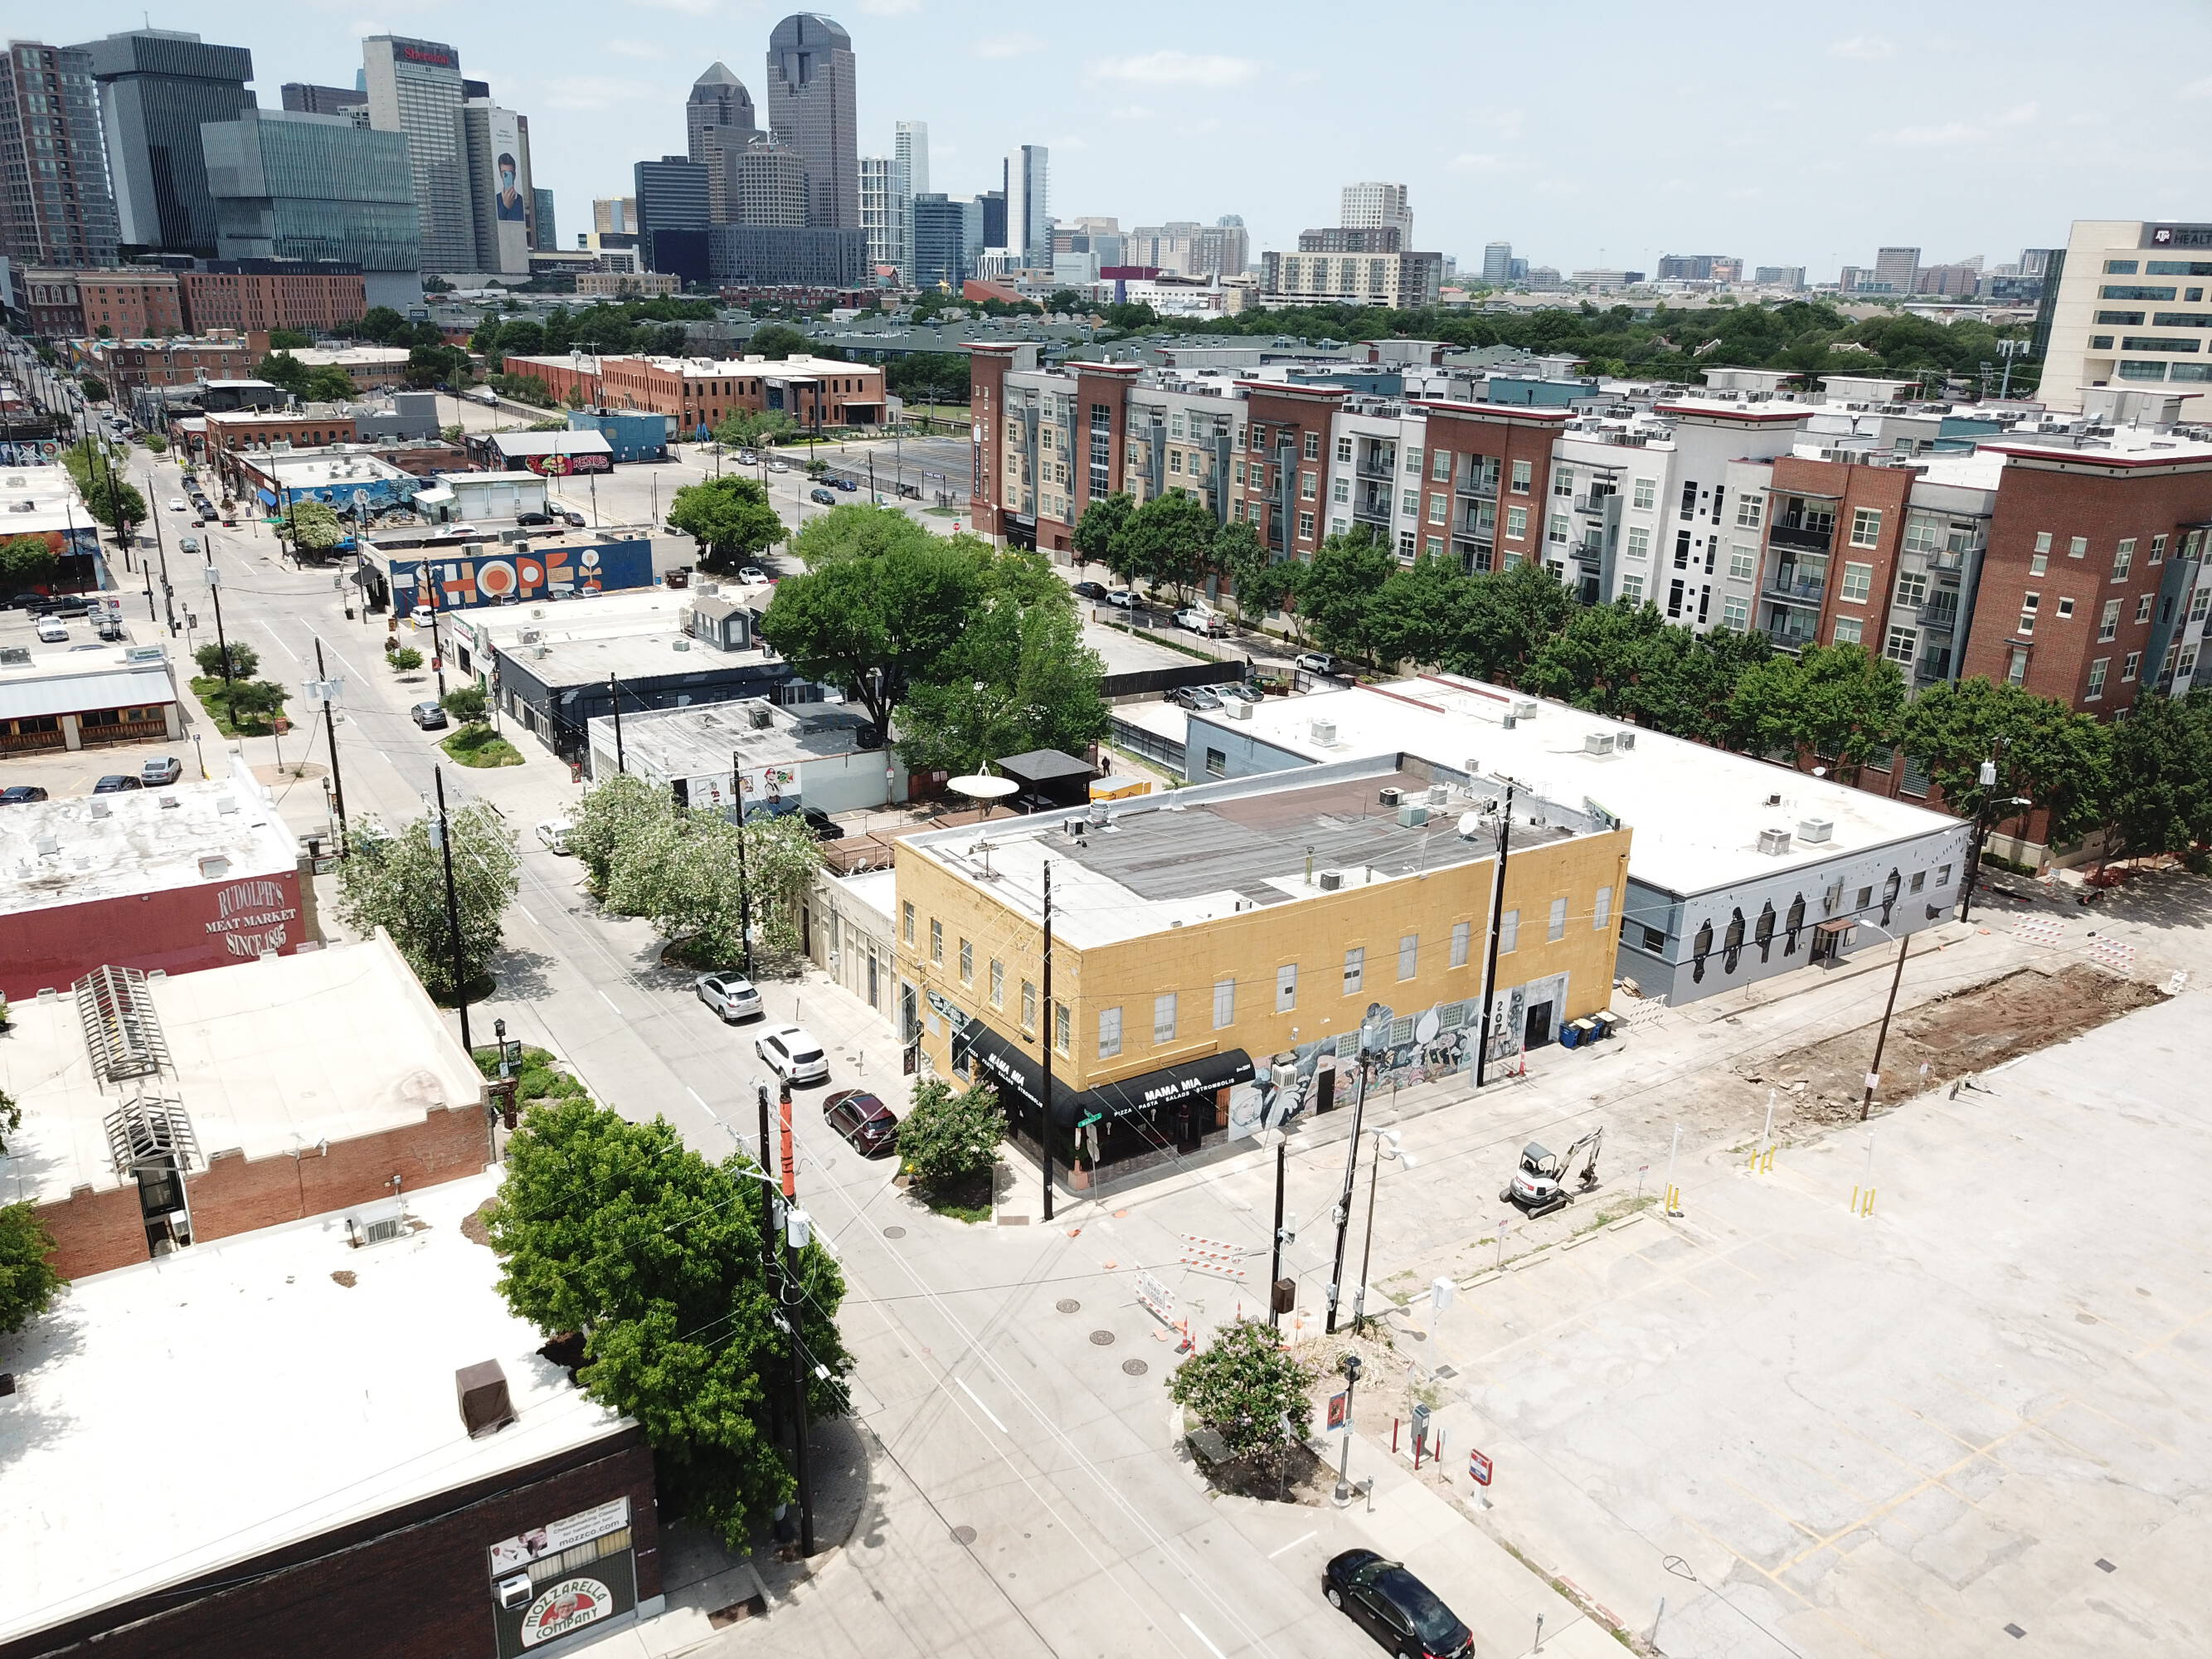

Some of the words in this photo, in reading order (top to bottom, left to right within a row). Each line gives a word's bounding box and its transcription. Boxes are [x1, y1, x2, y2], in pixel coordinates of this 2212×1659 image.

[404, 46, 450, 65] Sheraton
[573, 455, 608, 469] RENOS
[443, 552, 574, 605] HOPE
[217, 881, 284, 920] RUDOLPH'S
[205, 918, 240, 934] MEAT
[243, 908, 296, 928] MARKET
[226, 932, 262, 957] SINCE
[264, 922, 287, 951] 1895
[989, 1053, 1009, 1075] MAMA
[1010, 1069, 1025, 1087] MIA
[1114, 1107, 1132, 1117] PIZZA
[1138, 1100, 1159, 1111] PASTA
[1165, 1091, 1190, 1102] SALADS
[1196, 1078, 1235, 1093] STROMBOLIS
[1144, 1083, 1179, 1102] MAMA
[1181, 1077, 1203, 1091] MIA
[559, 1520, 620, 1547] mozzco.com
[525, 1580, 607, 1627] MOZZARELLA
[536, 1608, 598, 1639] COMPANY
